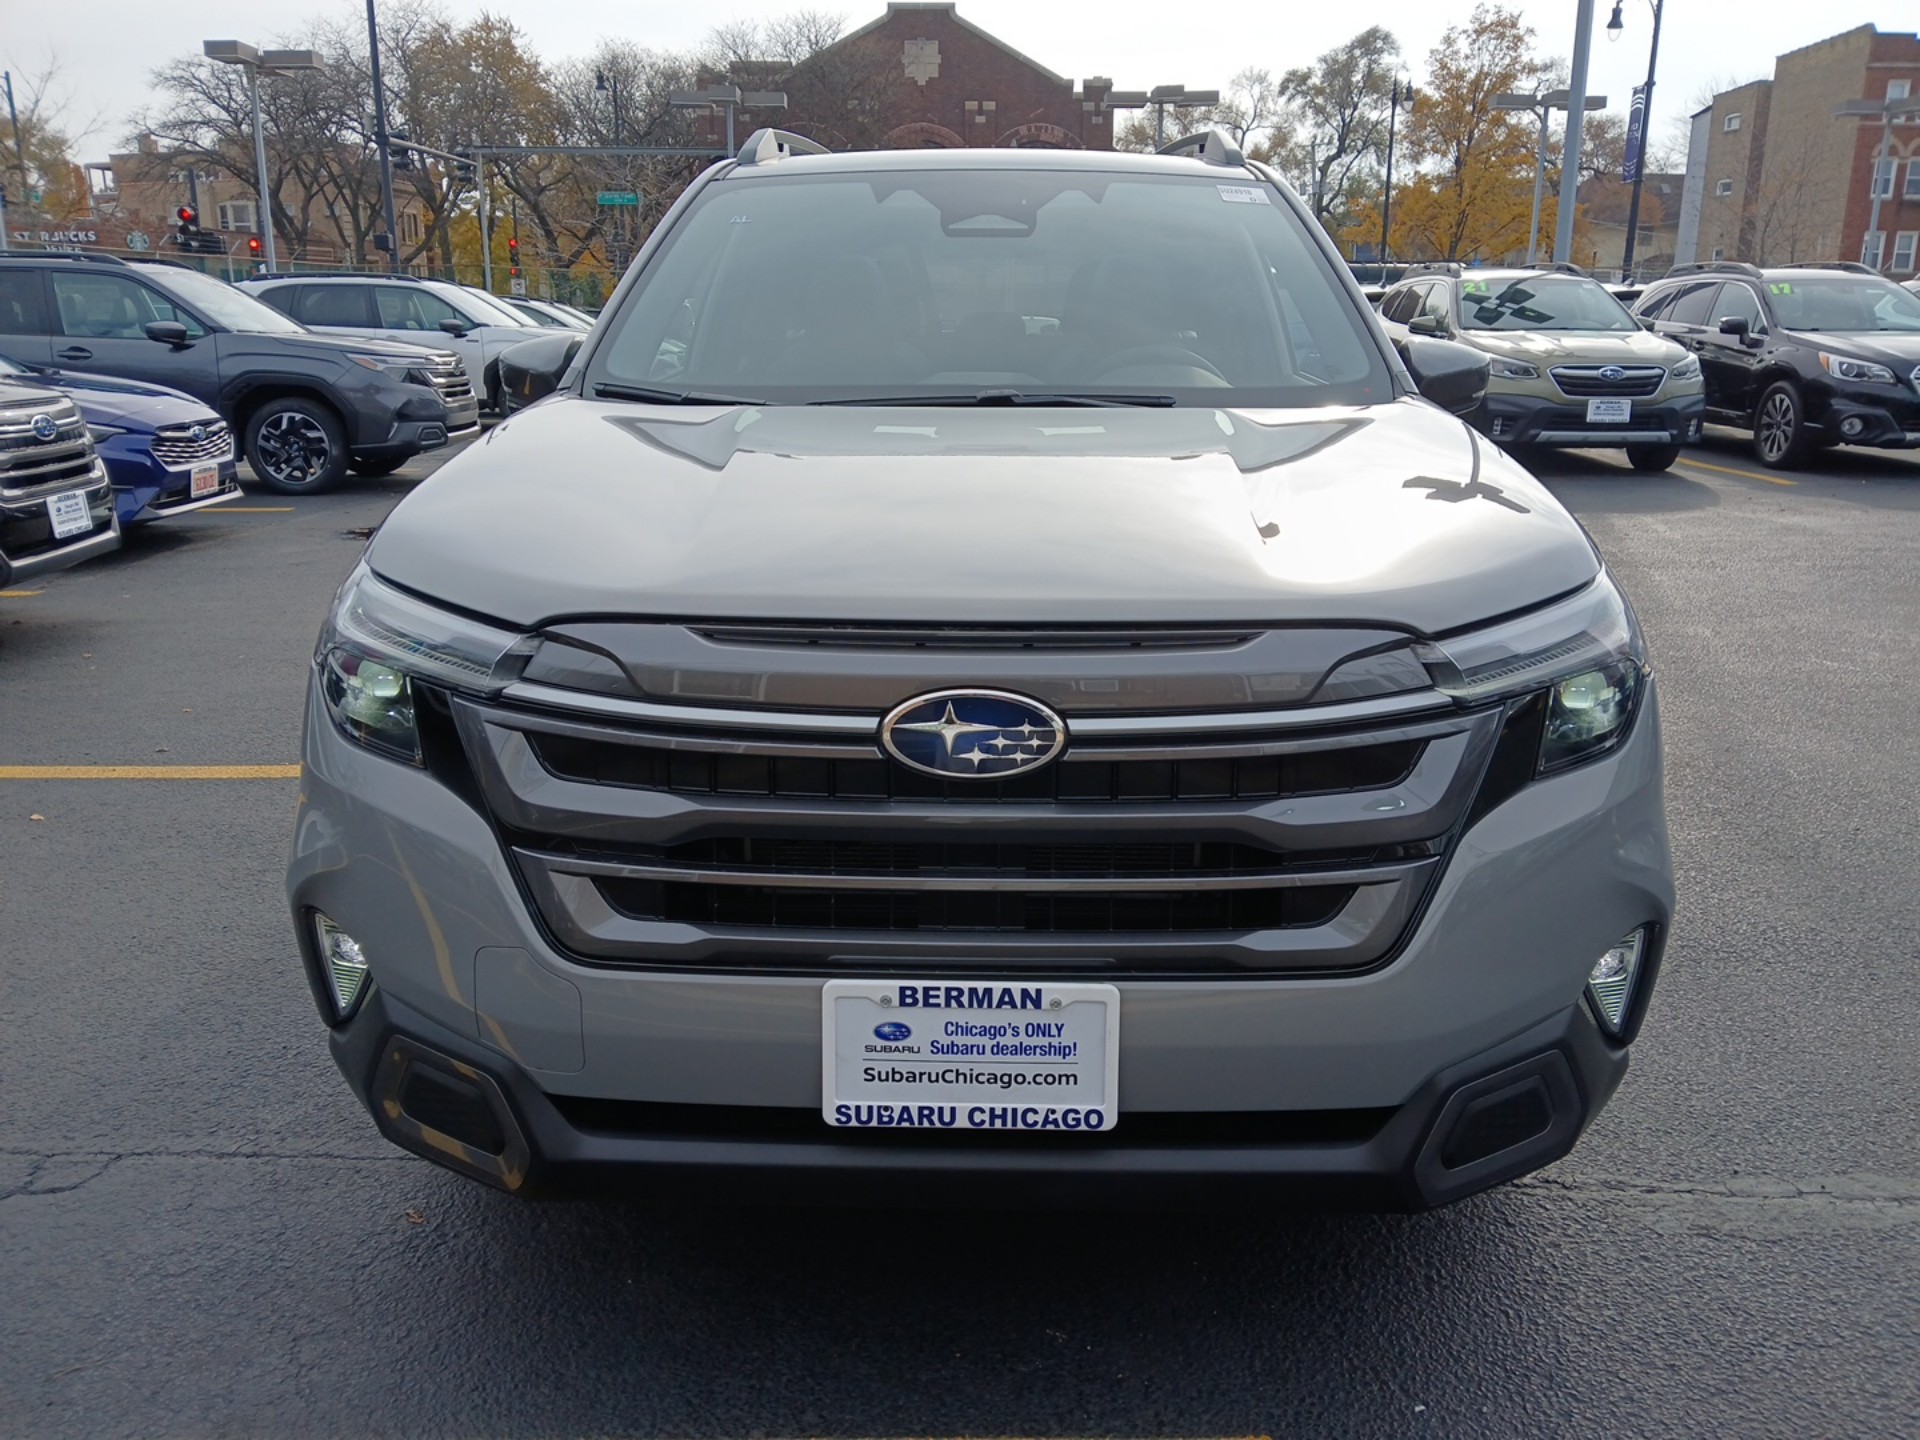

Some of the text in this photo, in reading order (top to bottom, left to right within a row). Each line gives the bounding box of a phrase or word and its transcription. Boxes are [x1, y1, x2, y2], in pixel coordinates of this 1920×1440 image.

[13, 231, 97, 241] STRBUCKS
[1463, 282, 1488, 293] 21
[1769, 283, 1791, 294] 17
[898, 985, 1042, 1010] BERMAN
[944, 1021, 1065, 1040] Chicago's ONLY
[864, 1044, 921, 1053] SUBARU
[930, 1040, 1077, 1059] Subaru dealership!
[863, 1067, 1078, 1089] SubaruChicago.com
[835, 1104, 1105, 1130] SUBARU CHICAGO
